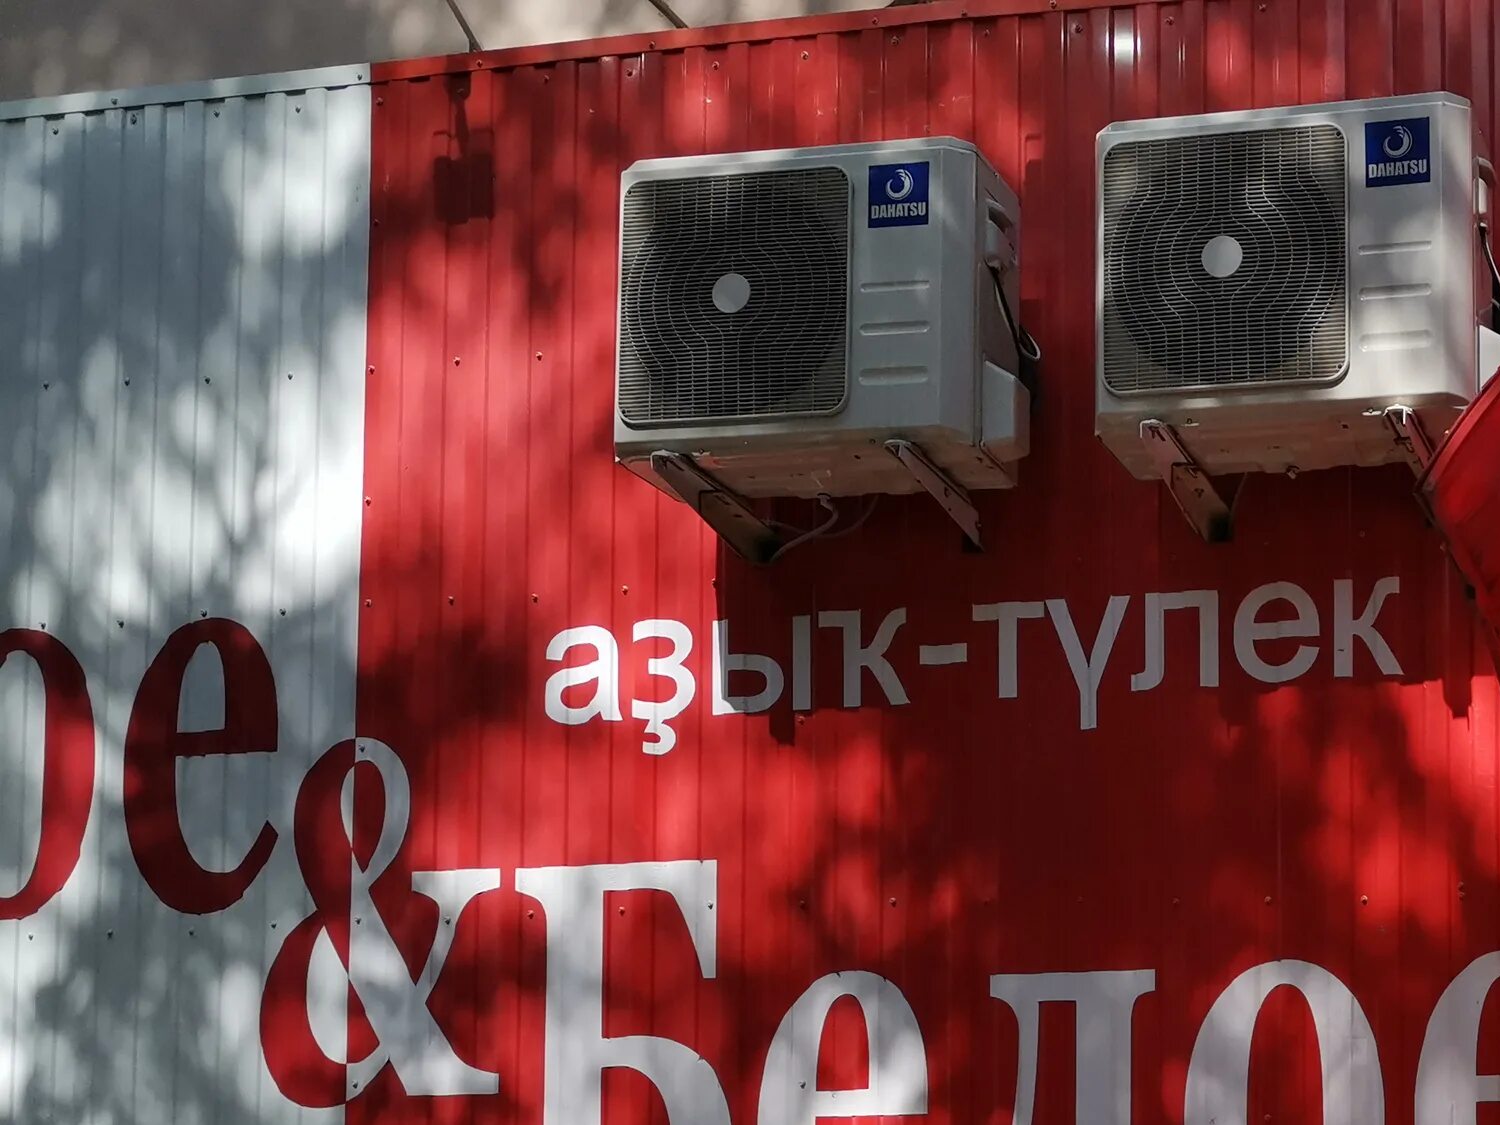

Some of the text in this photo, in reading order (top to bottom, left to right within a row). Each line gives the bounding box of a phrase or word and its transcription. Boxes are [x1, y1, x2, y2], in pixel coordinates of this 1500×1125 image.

[1368, 159, 1428, 178] DAHATSU
[871, 201, 927, 219] DAHATSU
[258, 738, 501, 1109] &
